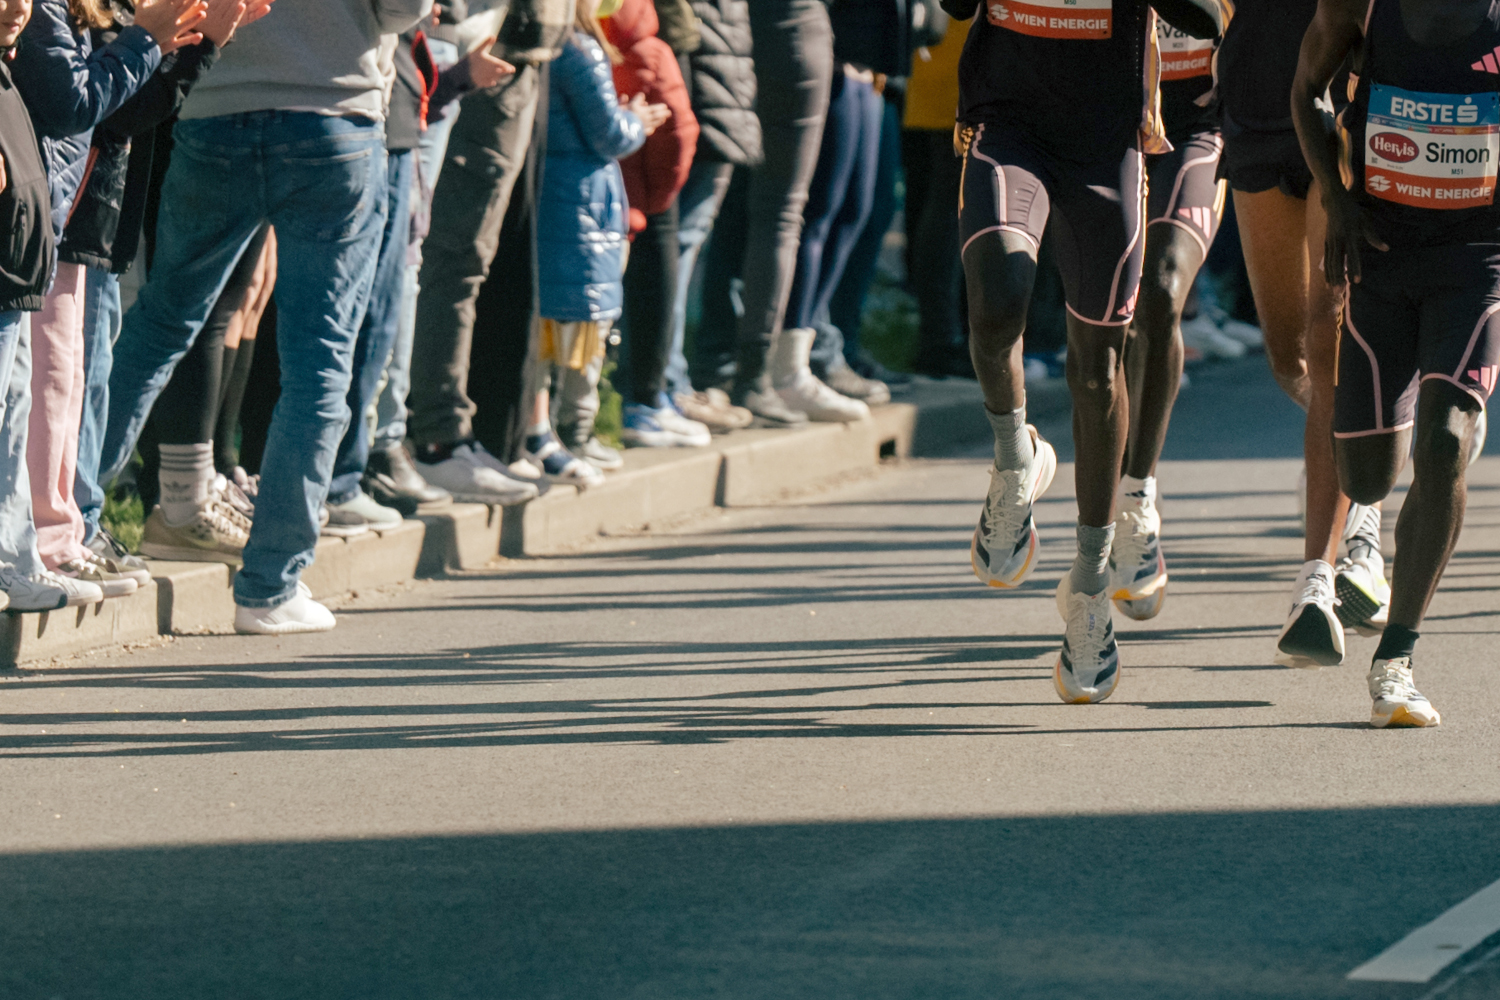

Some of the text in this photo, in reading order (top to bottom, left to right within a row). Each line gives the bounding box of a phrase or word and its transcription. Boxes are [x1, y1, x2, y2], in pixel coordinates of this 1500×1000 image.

[1013, 10, 1108, 30] WIEN ENERGIE
[1160, 56, 1208, 72] ENERGIE
[1390, 96, 1454, 123] ERSTE
[1374, 134, 1490, 164] Hervis Simon
[1395, 182, 1491, 200] WIEN ENERGIE
